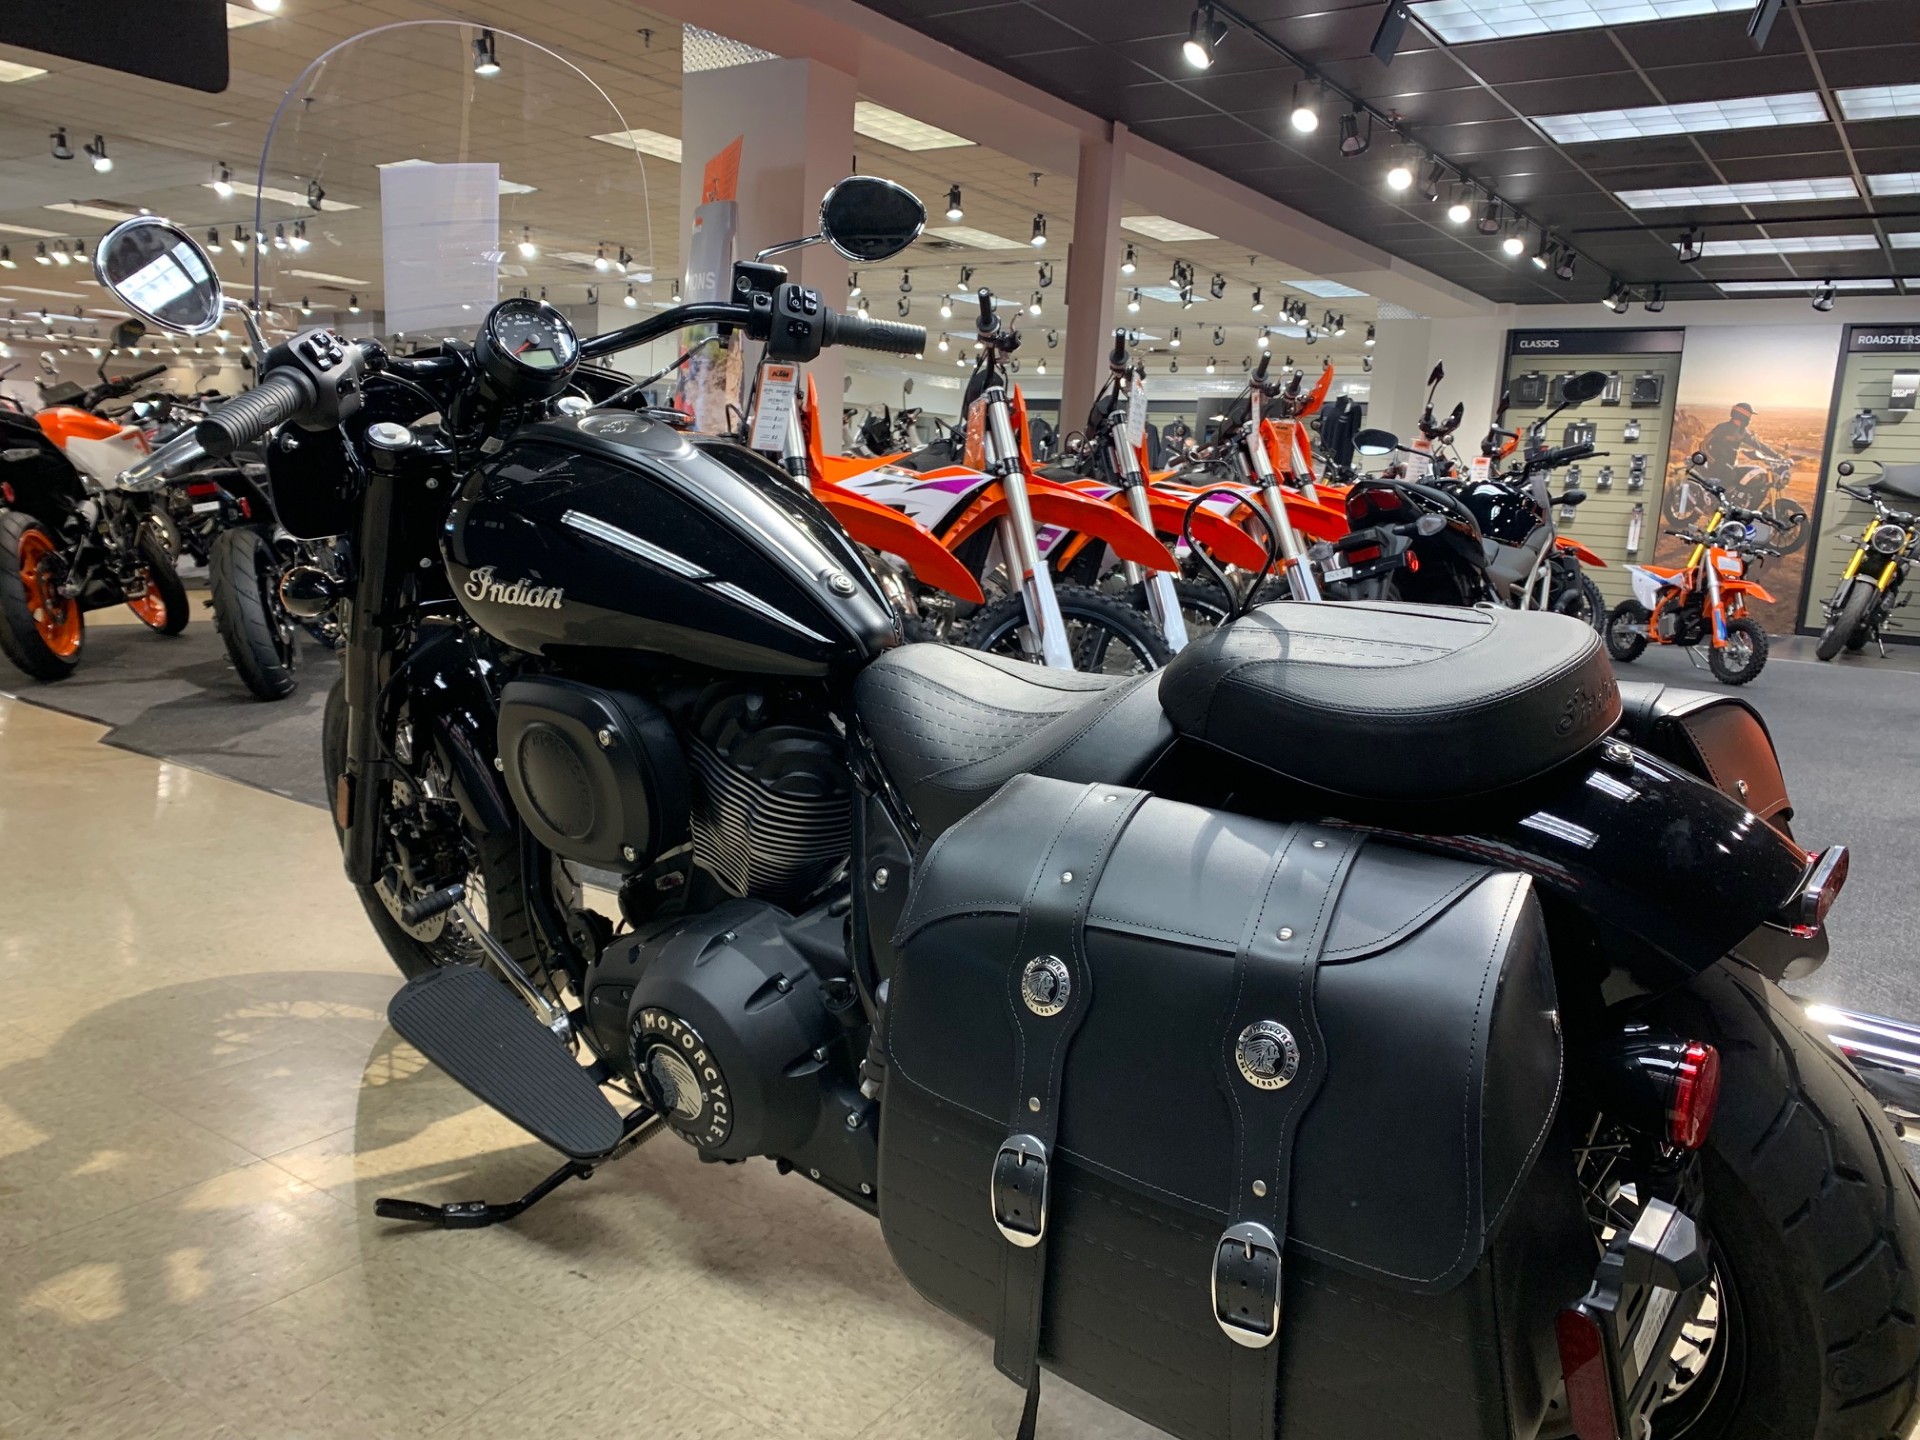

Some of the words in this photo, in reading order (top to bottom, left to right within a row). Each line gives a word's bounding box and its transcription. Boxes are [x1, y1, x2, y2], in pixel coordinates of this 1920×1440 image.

[1519, 339, 1560, 348] CLASSICS
[1858, 335, 1920, 345] ROADSTERS
[463, 565, 564, 610] Indian
[644, 1012, 728, 1139] MOTORCYCLE
